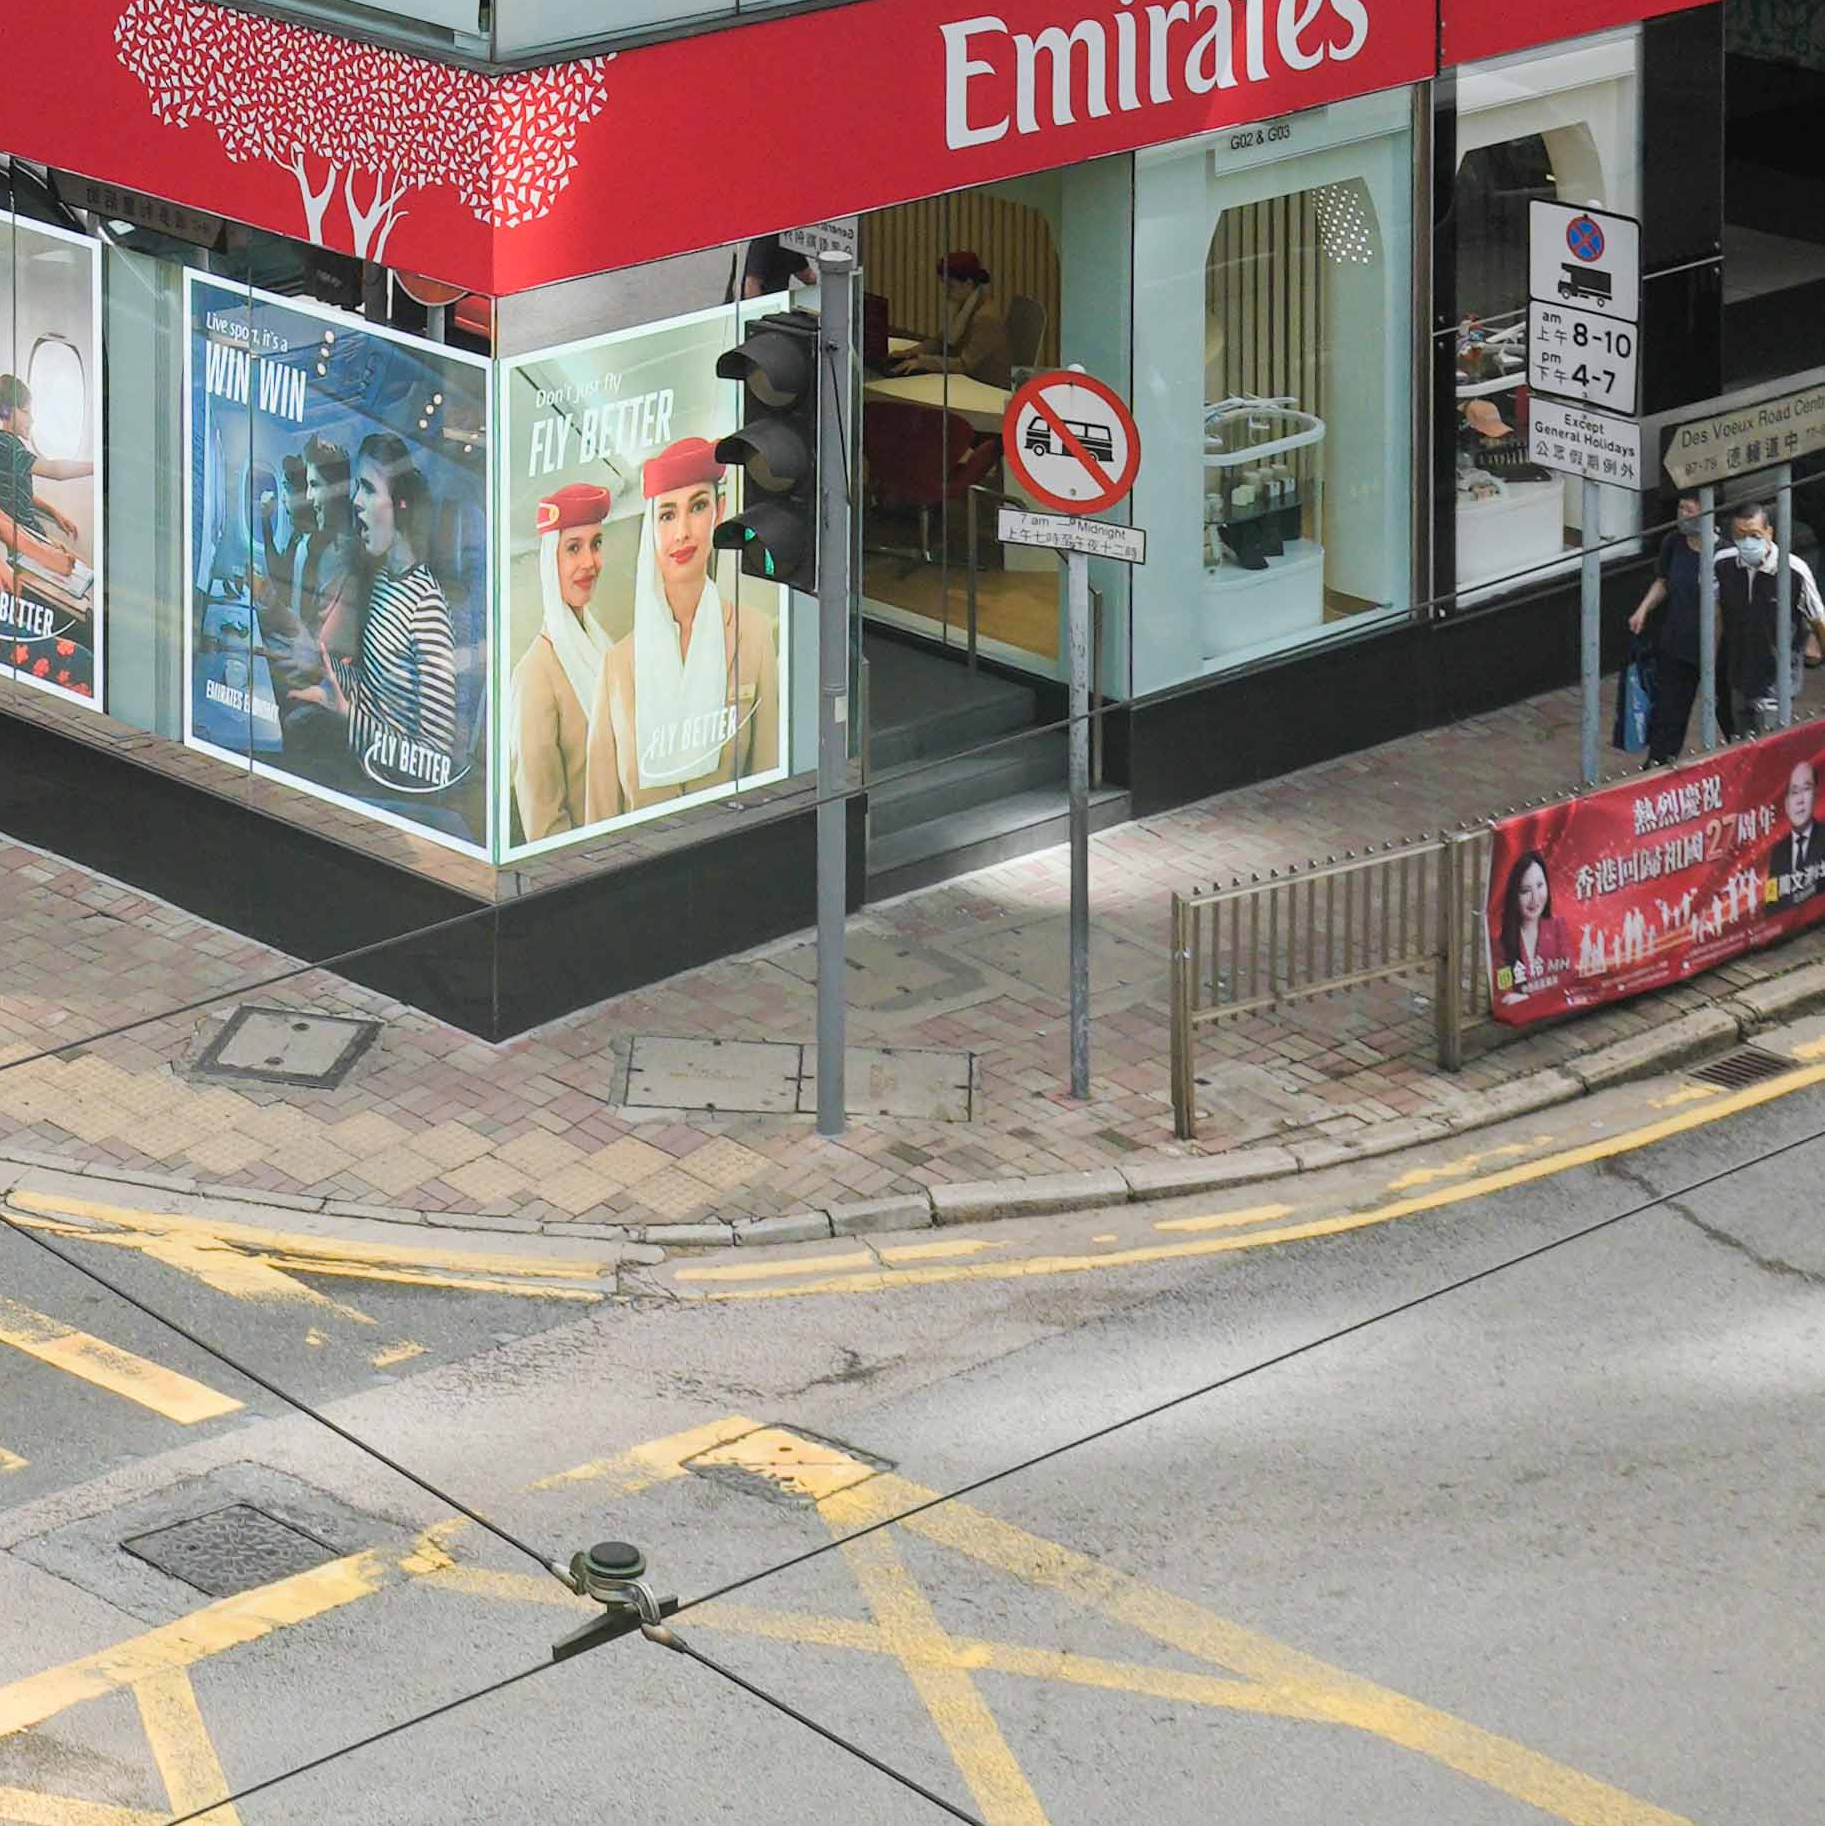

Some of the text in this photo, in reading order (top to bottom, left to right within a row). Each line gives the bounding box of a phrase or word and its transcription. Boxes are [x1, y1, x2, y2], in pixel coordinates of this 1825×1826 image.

[1230, 124, 1291, 150] G02 & G03
[206, 312, 228, 334] Live
[281, 338, 289, 353] a
[1542, 312, 1562, 325] am
[1536, 325, 1568, 346] 上午
[1573, 322, 1632, 359] 8-10
[1541, 351, 1562, 365] pm
[206, 340, 307, 423] WIN WIN
[1535, 364, 1569, 386] 下午
[1572, 364, 1616, 394] 4-7
[529, 388, 674, 478] FLY BETTER
[1535, 421, 1636, 458] General Holidays
[1564, 413, 1605, 436] Except
[1681, 429, 1709, 449] Des
[1712, 419, 1755, 441] Voeux
[1758, 404, 1791, 427] Road
[1020, 513, 1126, 540] 7 am Midnight
[372, 731, 452, 785] FLY BETTER
